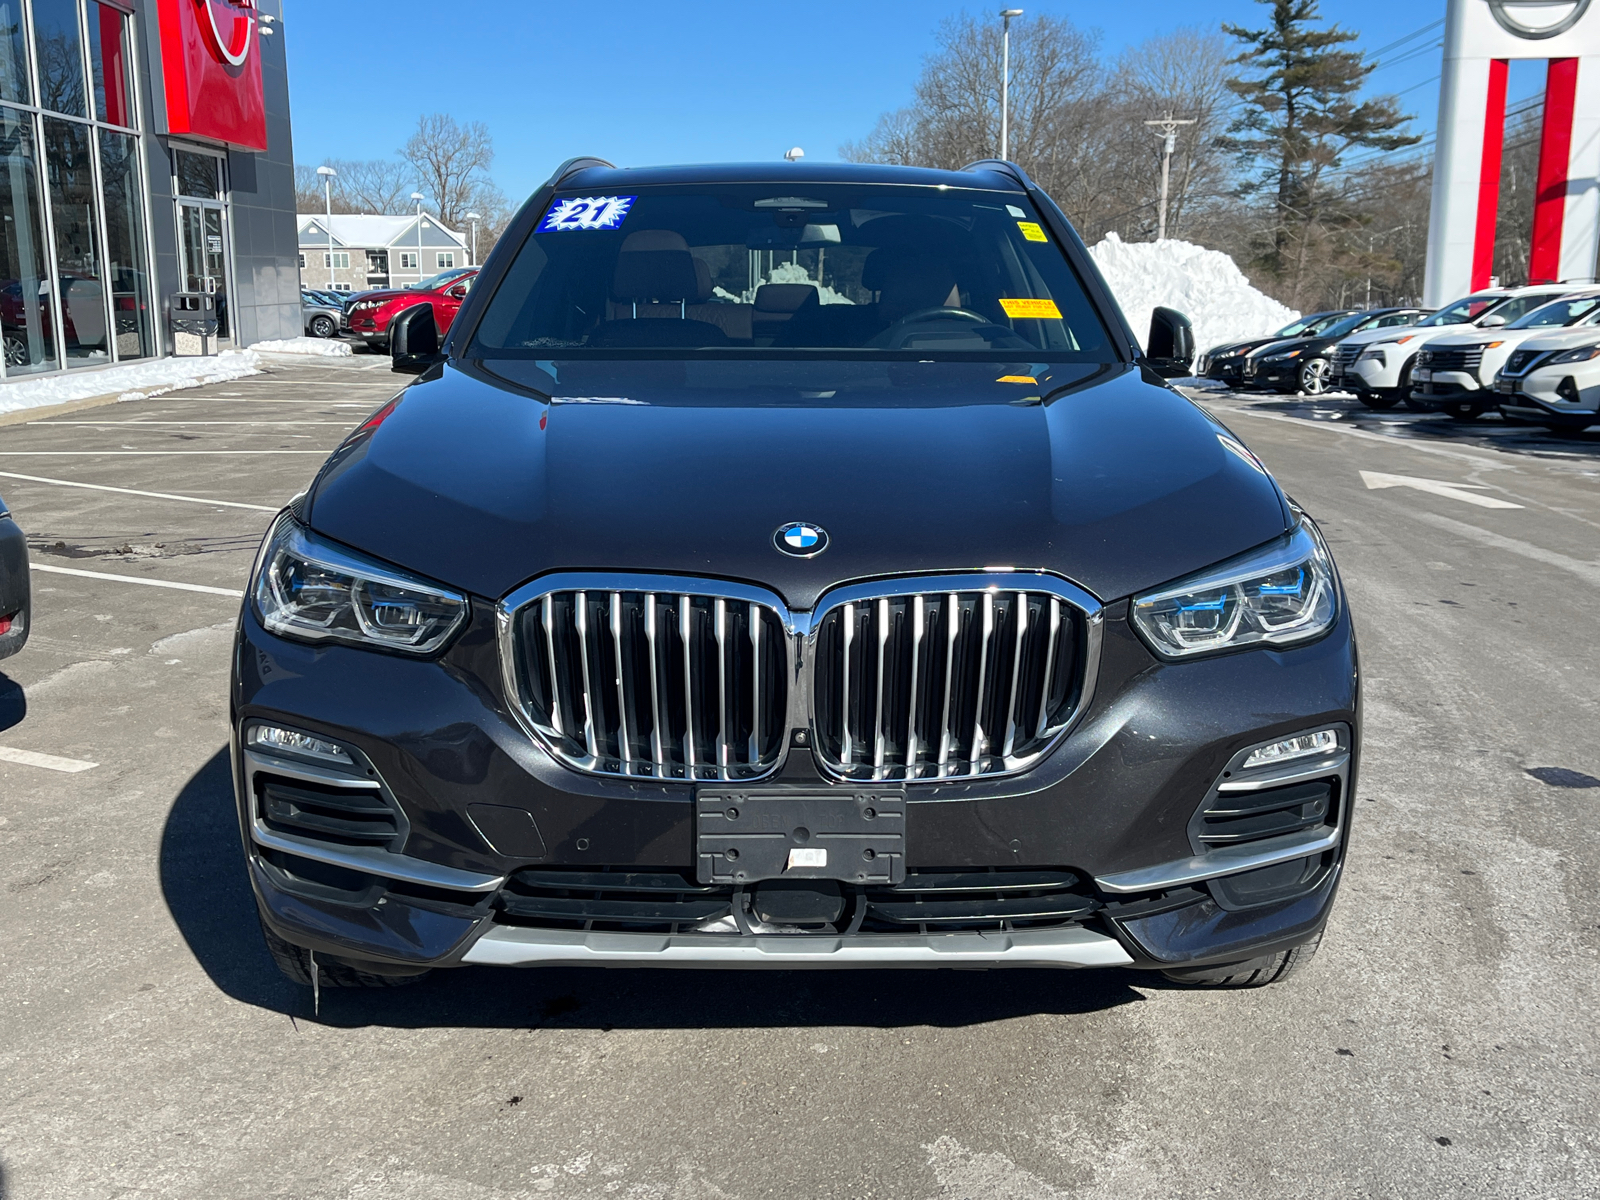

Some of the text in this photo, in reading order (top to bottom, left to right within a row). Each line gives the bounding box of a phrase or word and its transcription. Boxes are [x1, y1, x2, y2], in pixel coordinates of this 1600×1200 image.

[560, 202, 611, 223] 21
[779, 523, 825, 533] BMW
[819, 814, 844, 829] TOP
